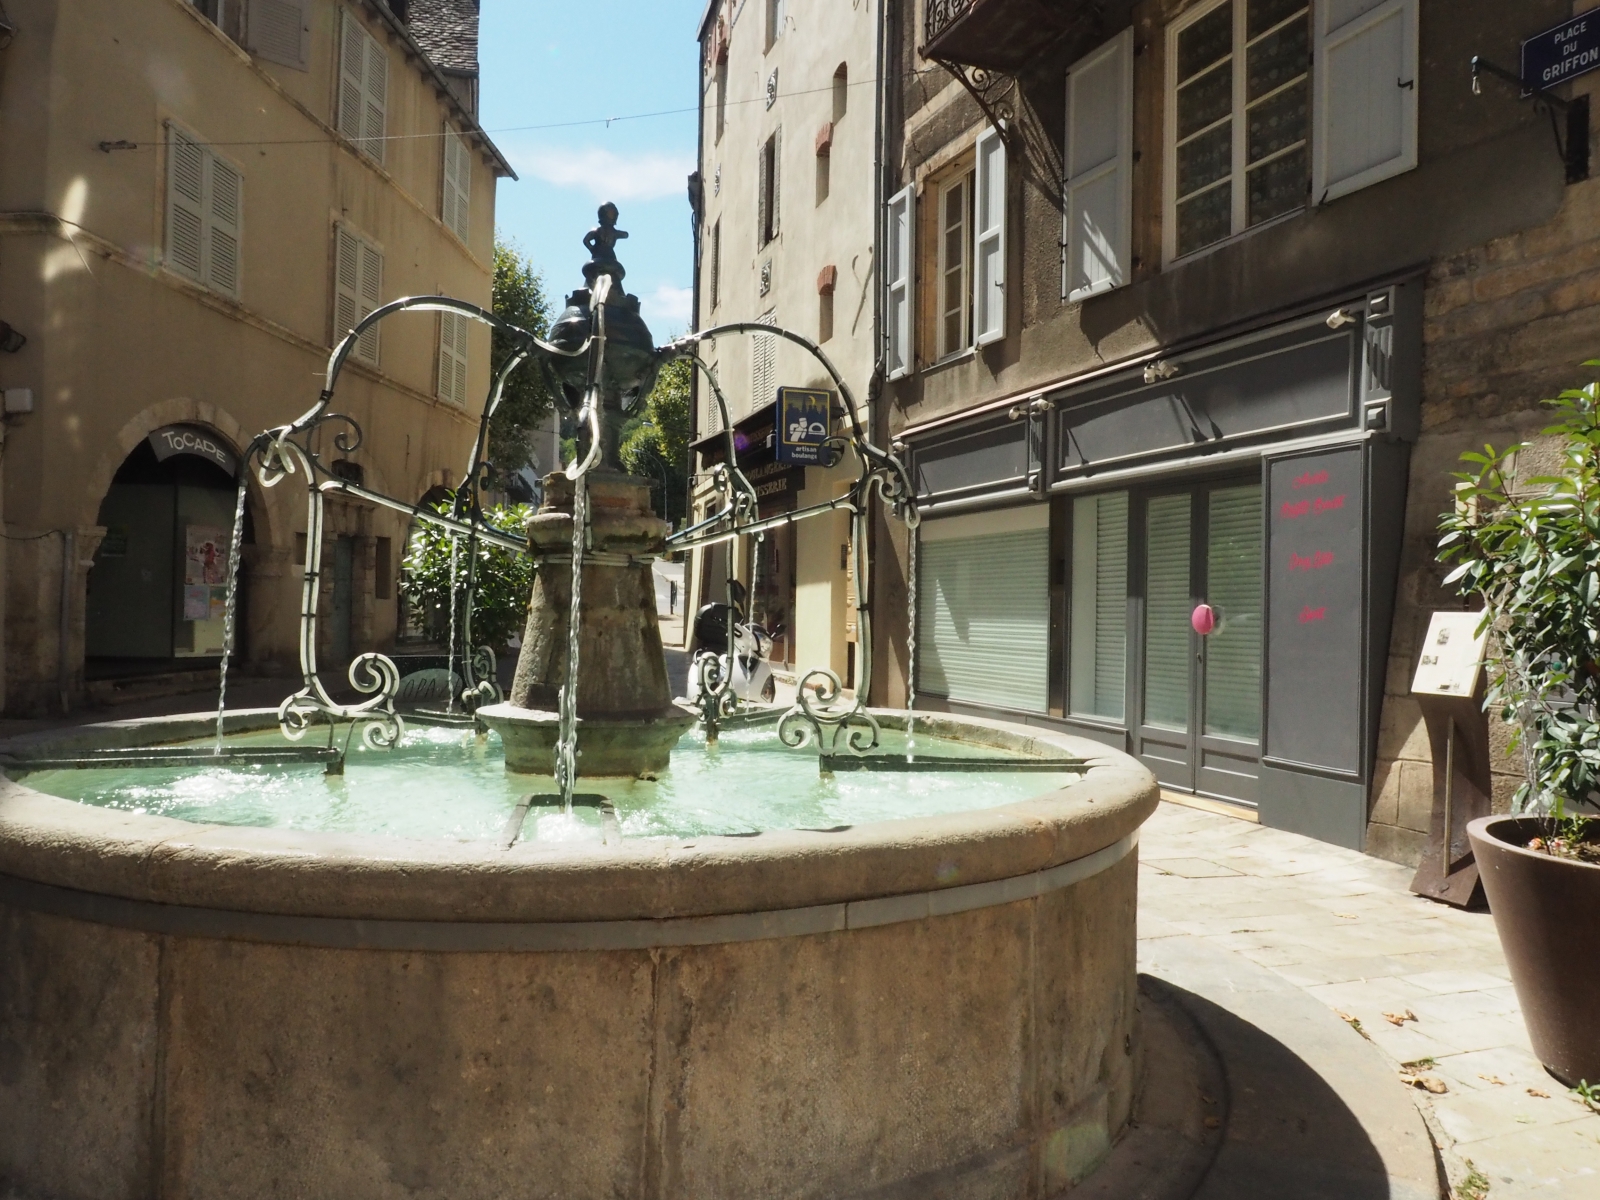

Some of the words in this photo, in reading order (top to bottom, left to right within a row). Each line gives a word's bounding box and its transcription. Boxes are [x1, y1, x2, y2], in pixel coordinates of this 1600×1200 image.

[1554, 21, 1587, 45] PLACE
[1563, 40, 1578, 56] DU
[1542, 46, 1599, 81] GRIFFON
[791, 451, 818, 460] boulange
